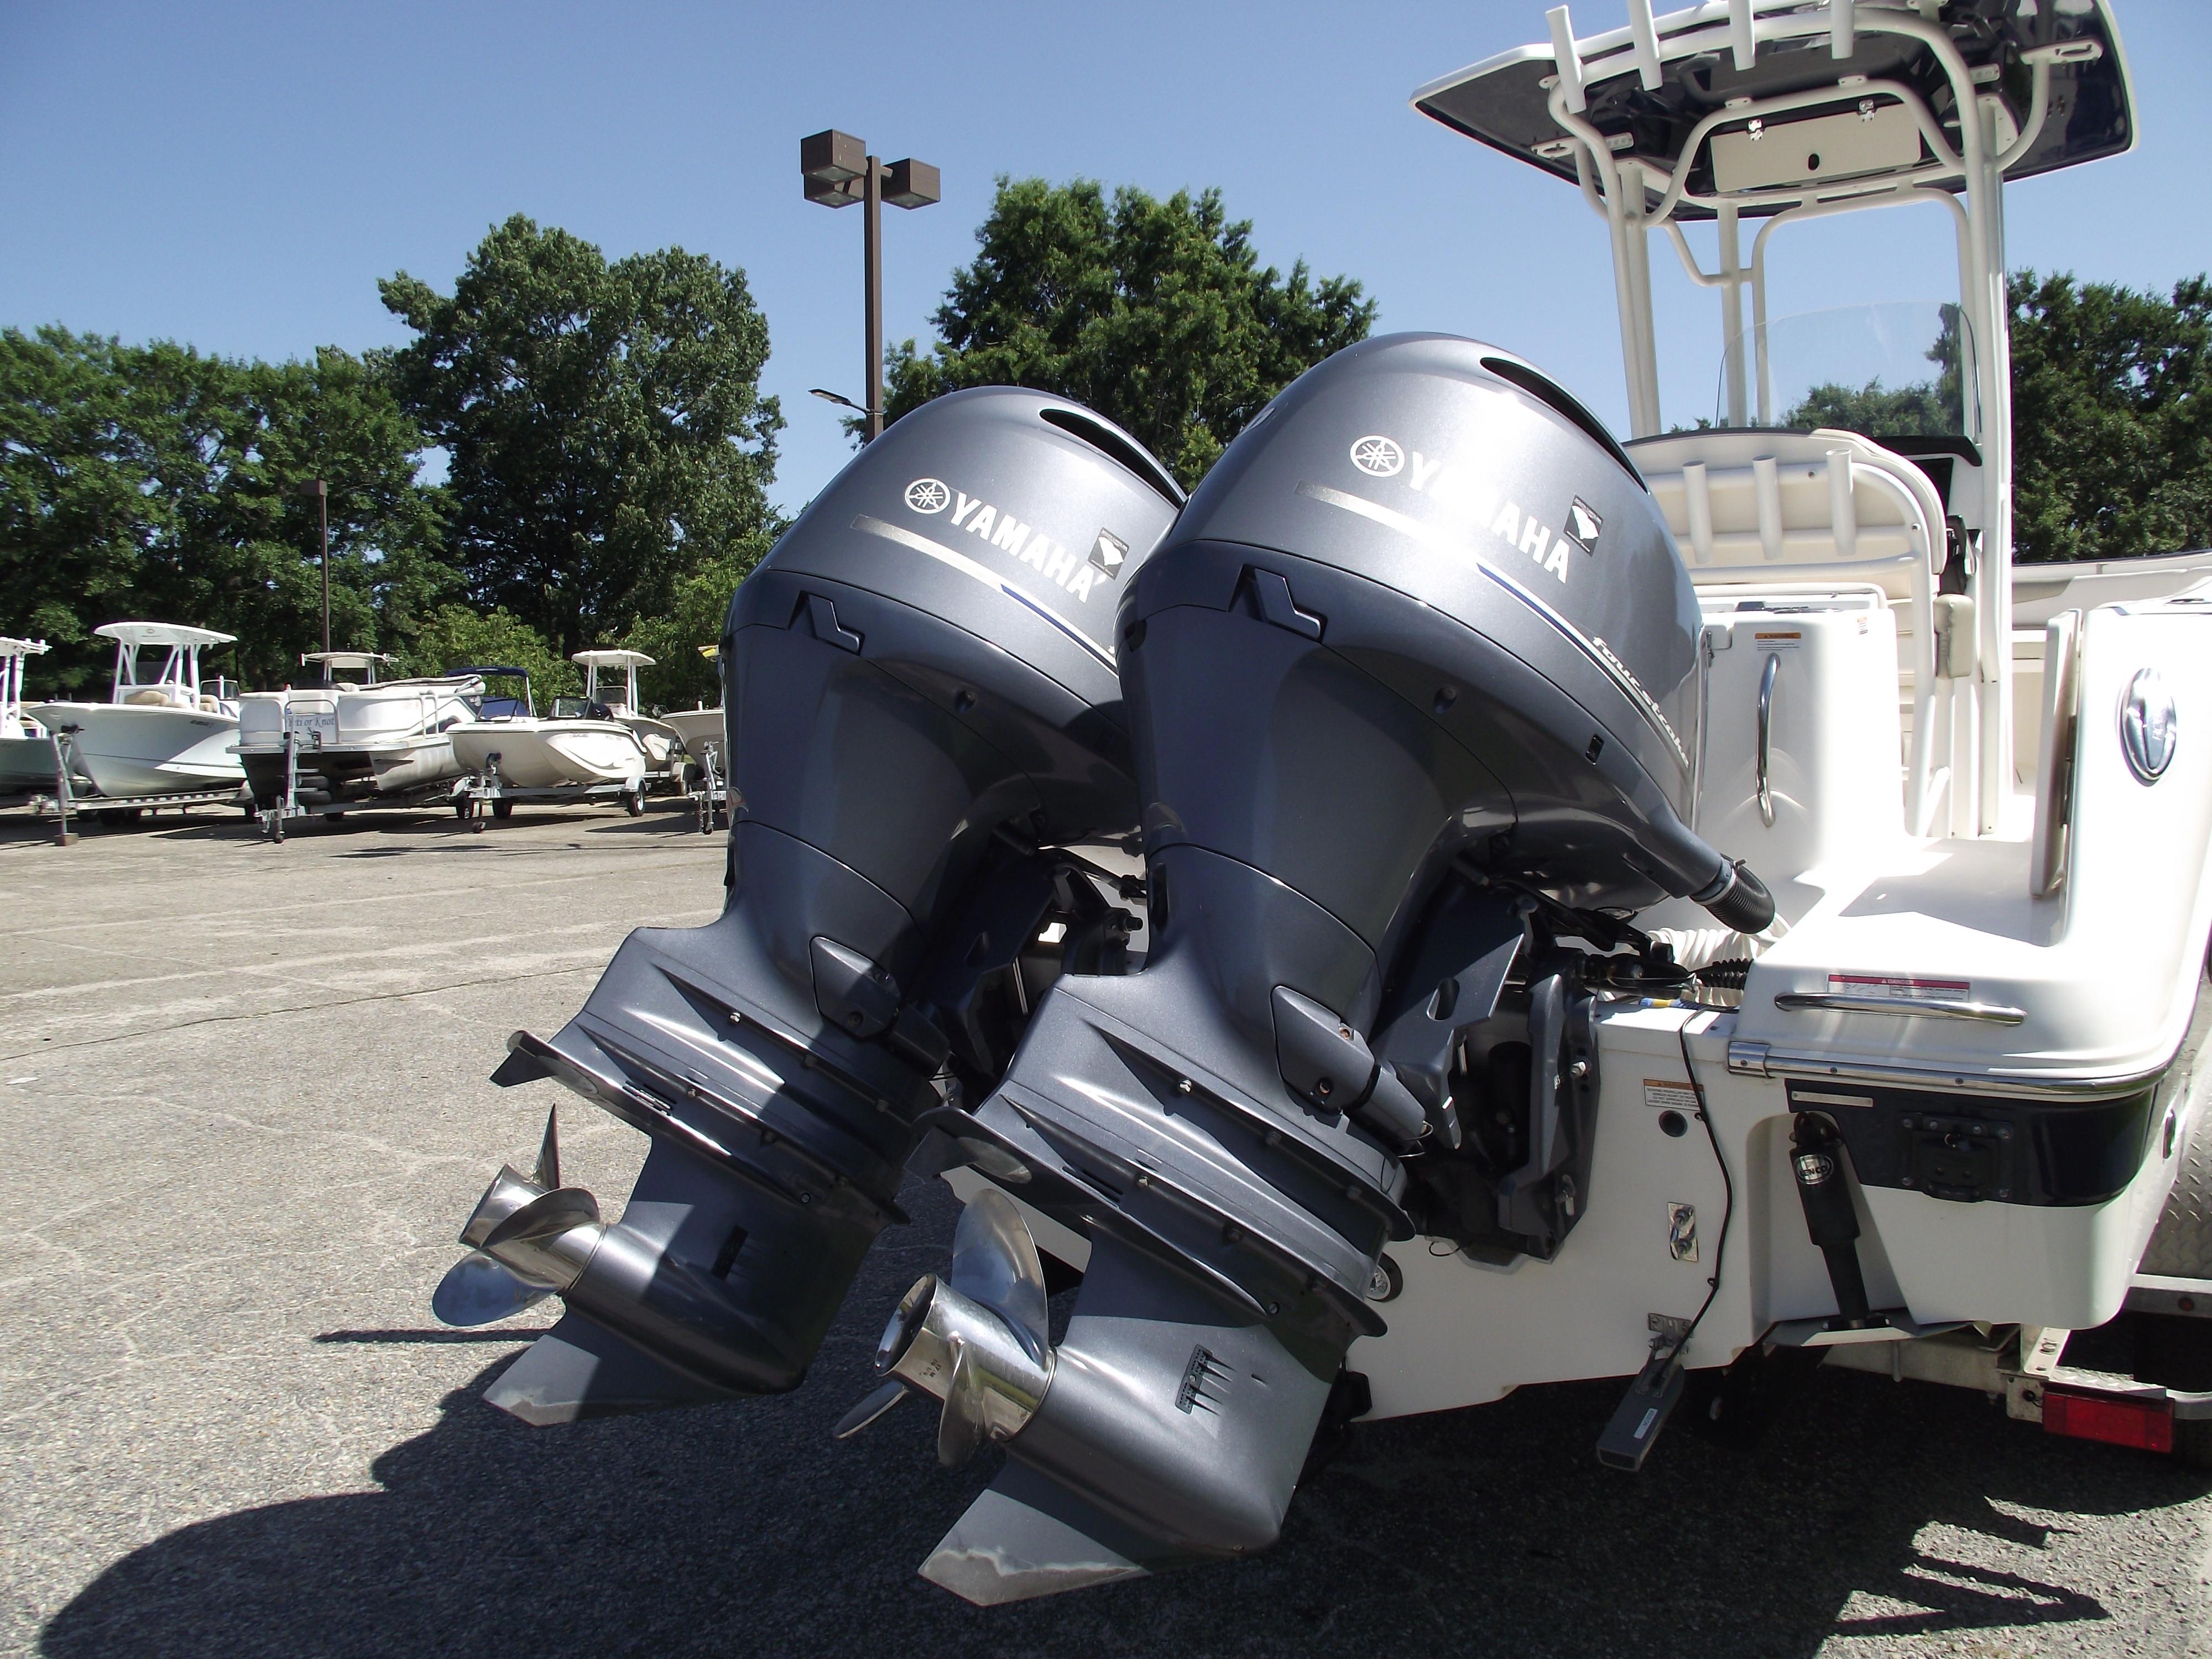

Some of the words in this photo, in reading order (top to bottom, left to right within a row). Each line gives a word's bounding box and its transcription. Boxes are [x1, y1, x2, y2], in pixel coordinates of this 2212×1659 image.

[951, 493, 1095, 603] YAMAHA
[1410, 451, 1569, 583] YAHA
[1799, 1165, 1826, 1176] LENCO
